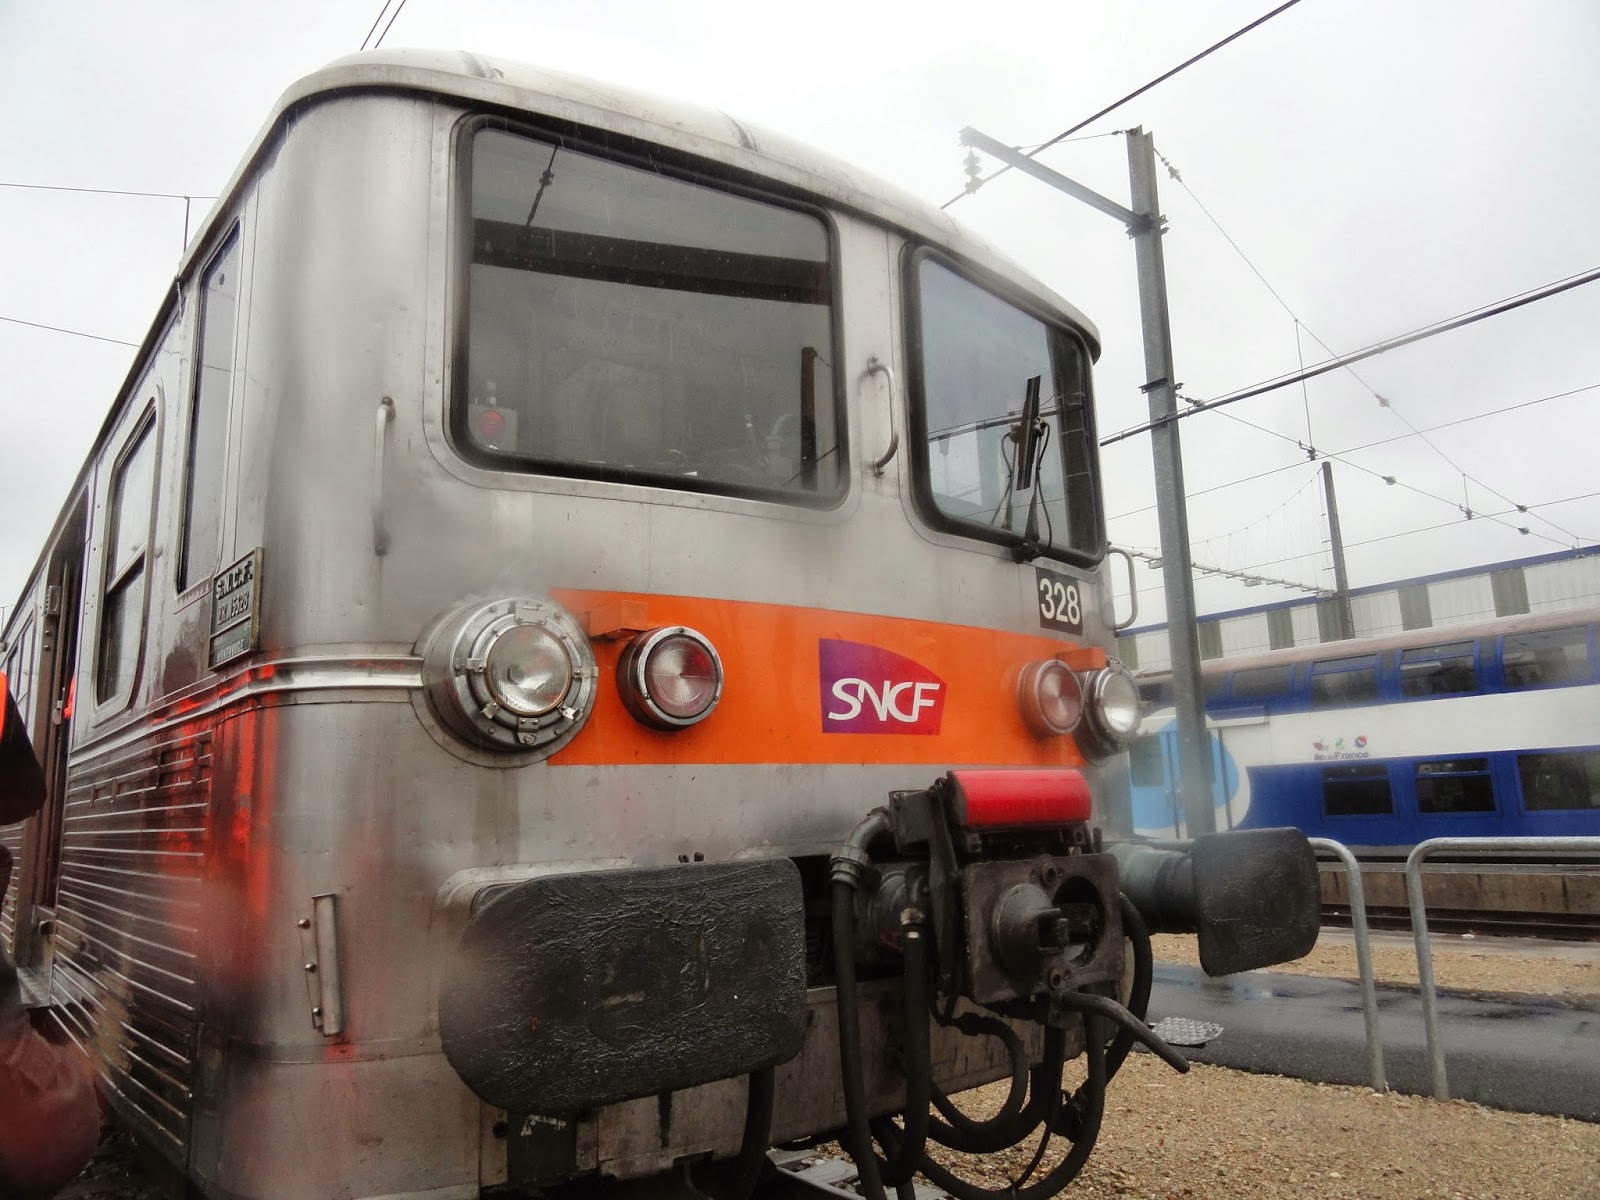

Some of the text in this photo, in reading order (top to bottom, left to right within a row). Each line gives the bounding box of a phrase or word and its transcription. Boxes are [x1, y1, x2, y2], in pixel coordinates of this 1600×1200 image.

[1039, 578, 1081, 625] 328
[828, 677, 940, 723] SNCF
[1334, 751, 1369, 760] France
